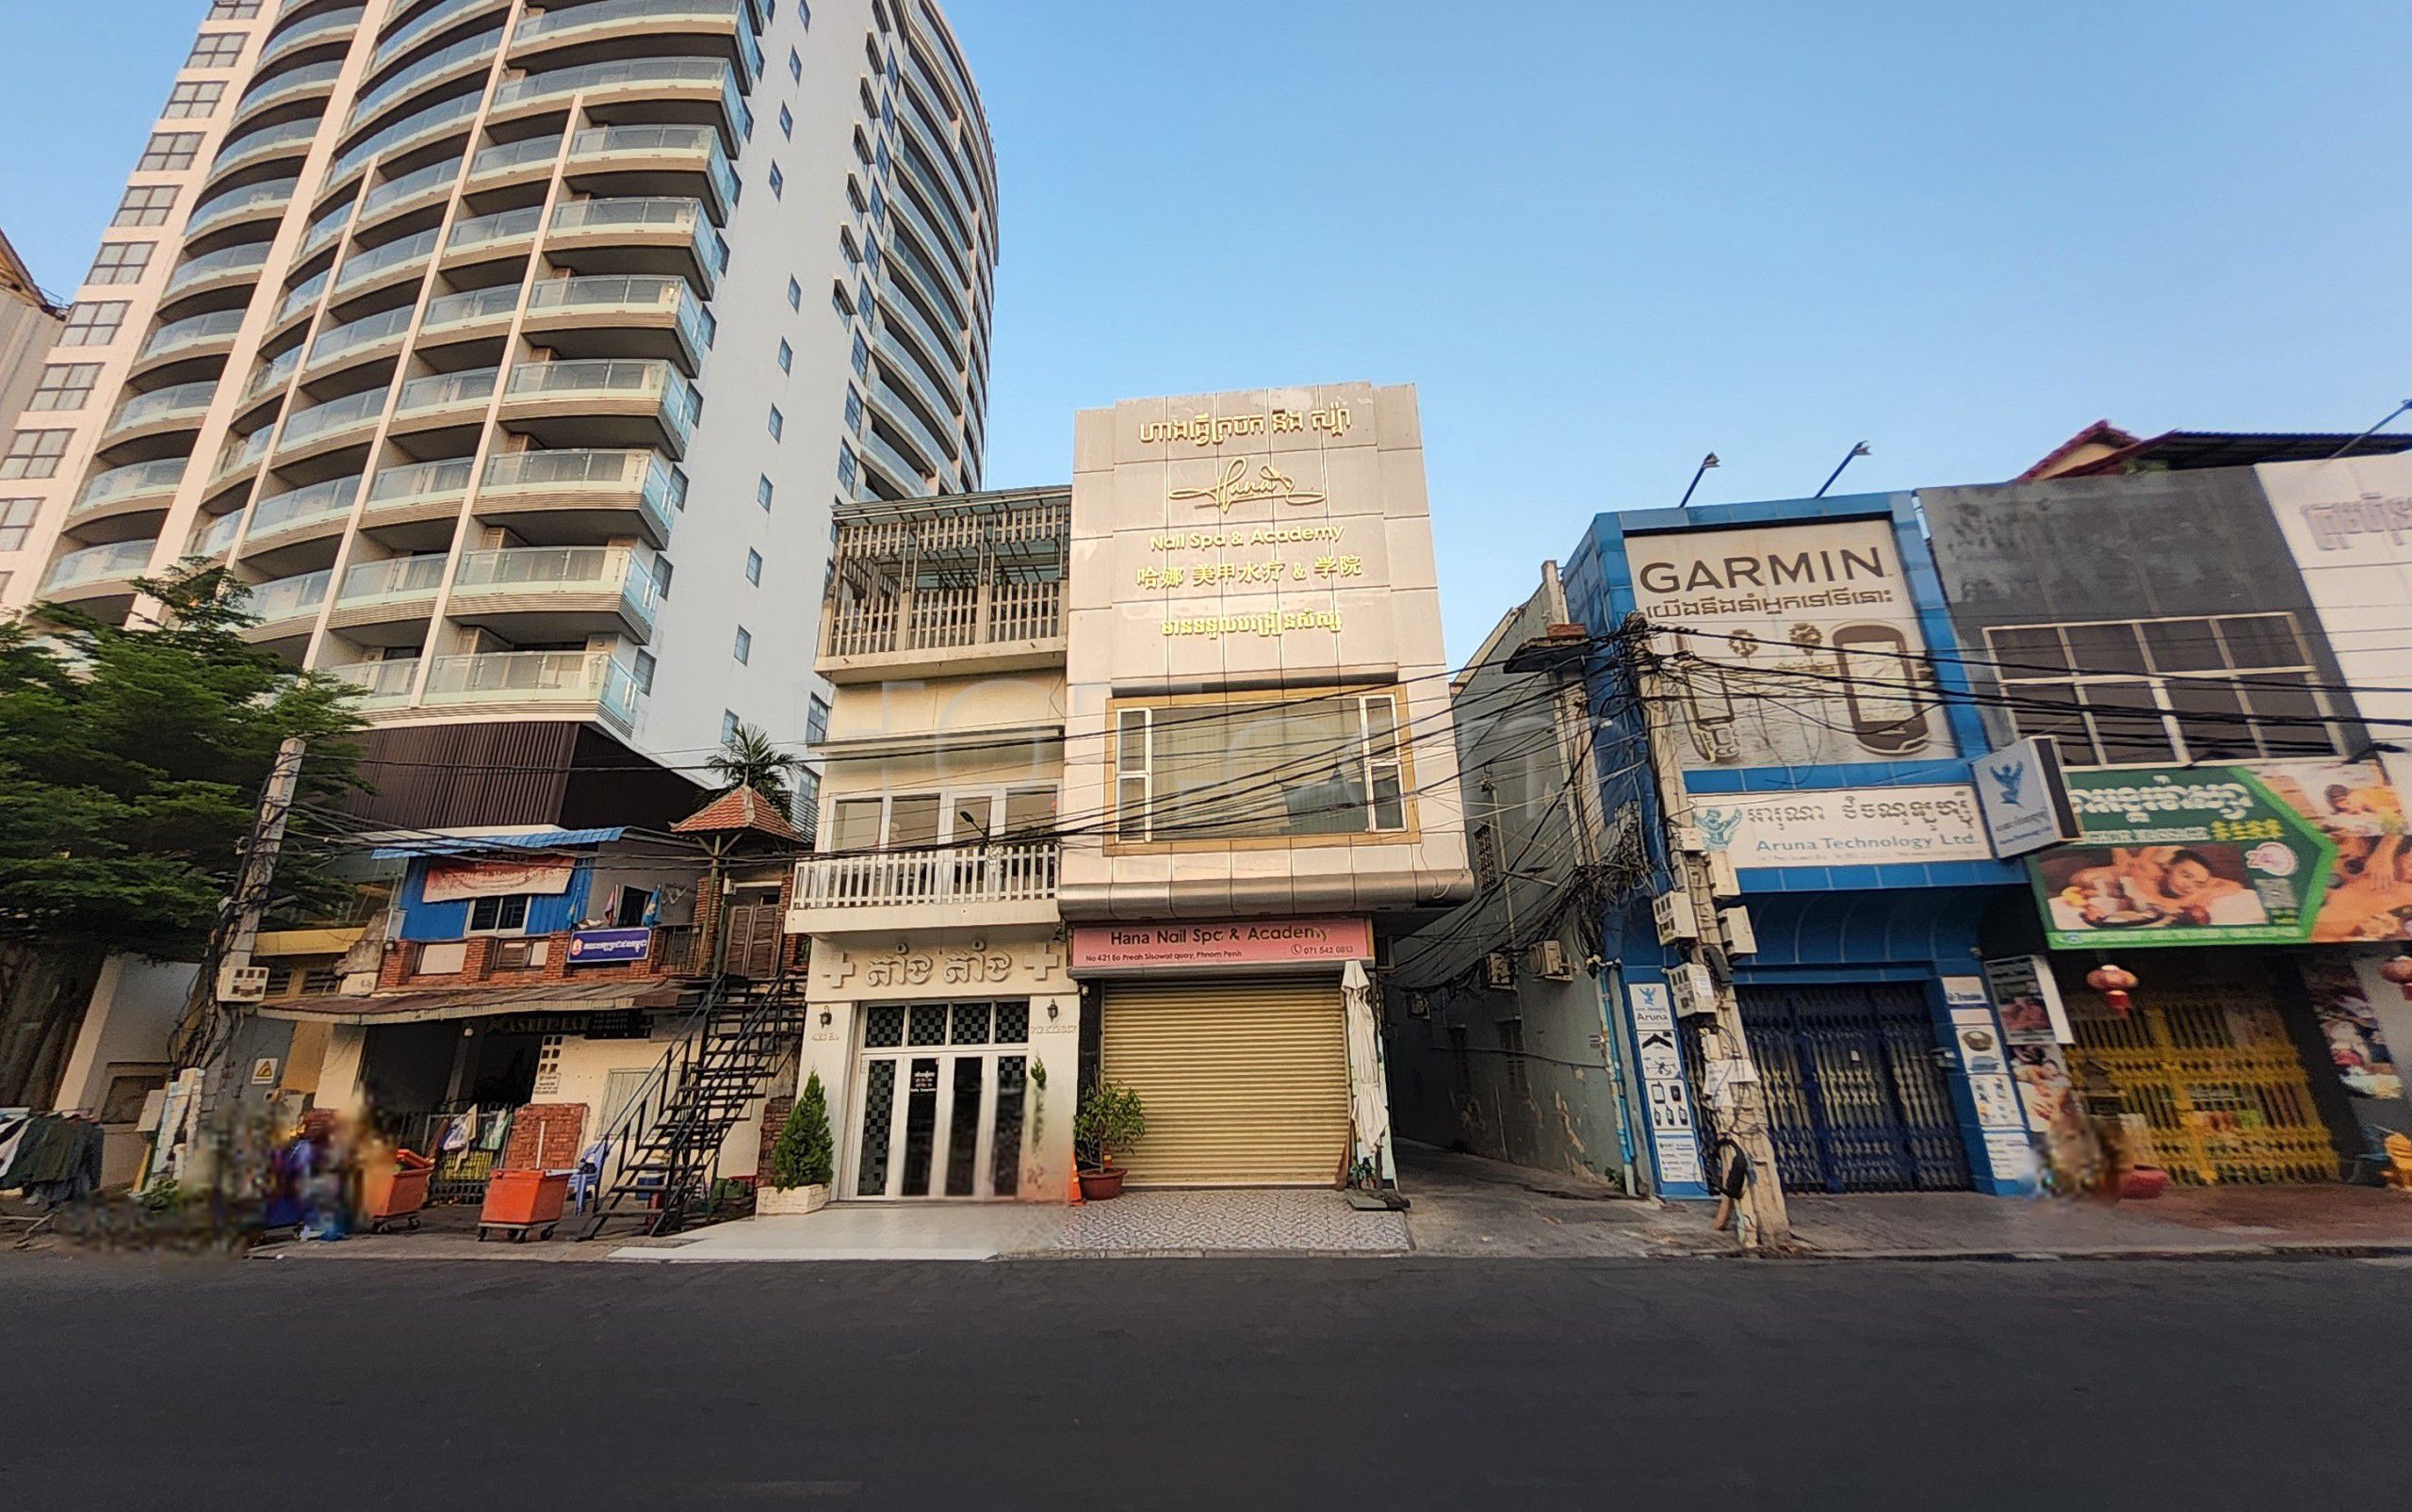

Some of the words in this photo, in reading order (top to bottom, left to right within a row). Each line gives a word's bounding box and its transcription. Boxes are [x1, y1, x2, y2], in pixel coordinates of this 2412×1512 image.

[1149, 532, 1186, 551] Nail
[1190, 532, 1226, 551] Spa
[1230, 530, 1244, 546] &
[1250, 525, 1345, 545] Academy
[1136, 565, 1184, 590] 哈娜
[1192, 560, 1286, 587] 美甲水疗
[1292, 562, 1307, 580] &
[1313, 554, 1364, 578] 学院
[1639, 546, 1885, 594] GARMIN
[1756, 839, 1817, 852] Aruna
[1819, 836, 1933, 850] Technology
[1111, 931, 1150, 945] Hana
[1157, 929, 1187, 944] Nail
[1229, 926, 1240, 941] &
[1637, 1013, 1669, 1021] Aruna
